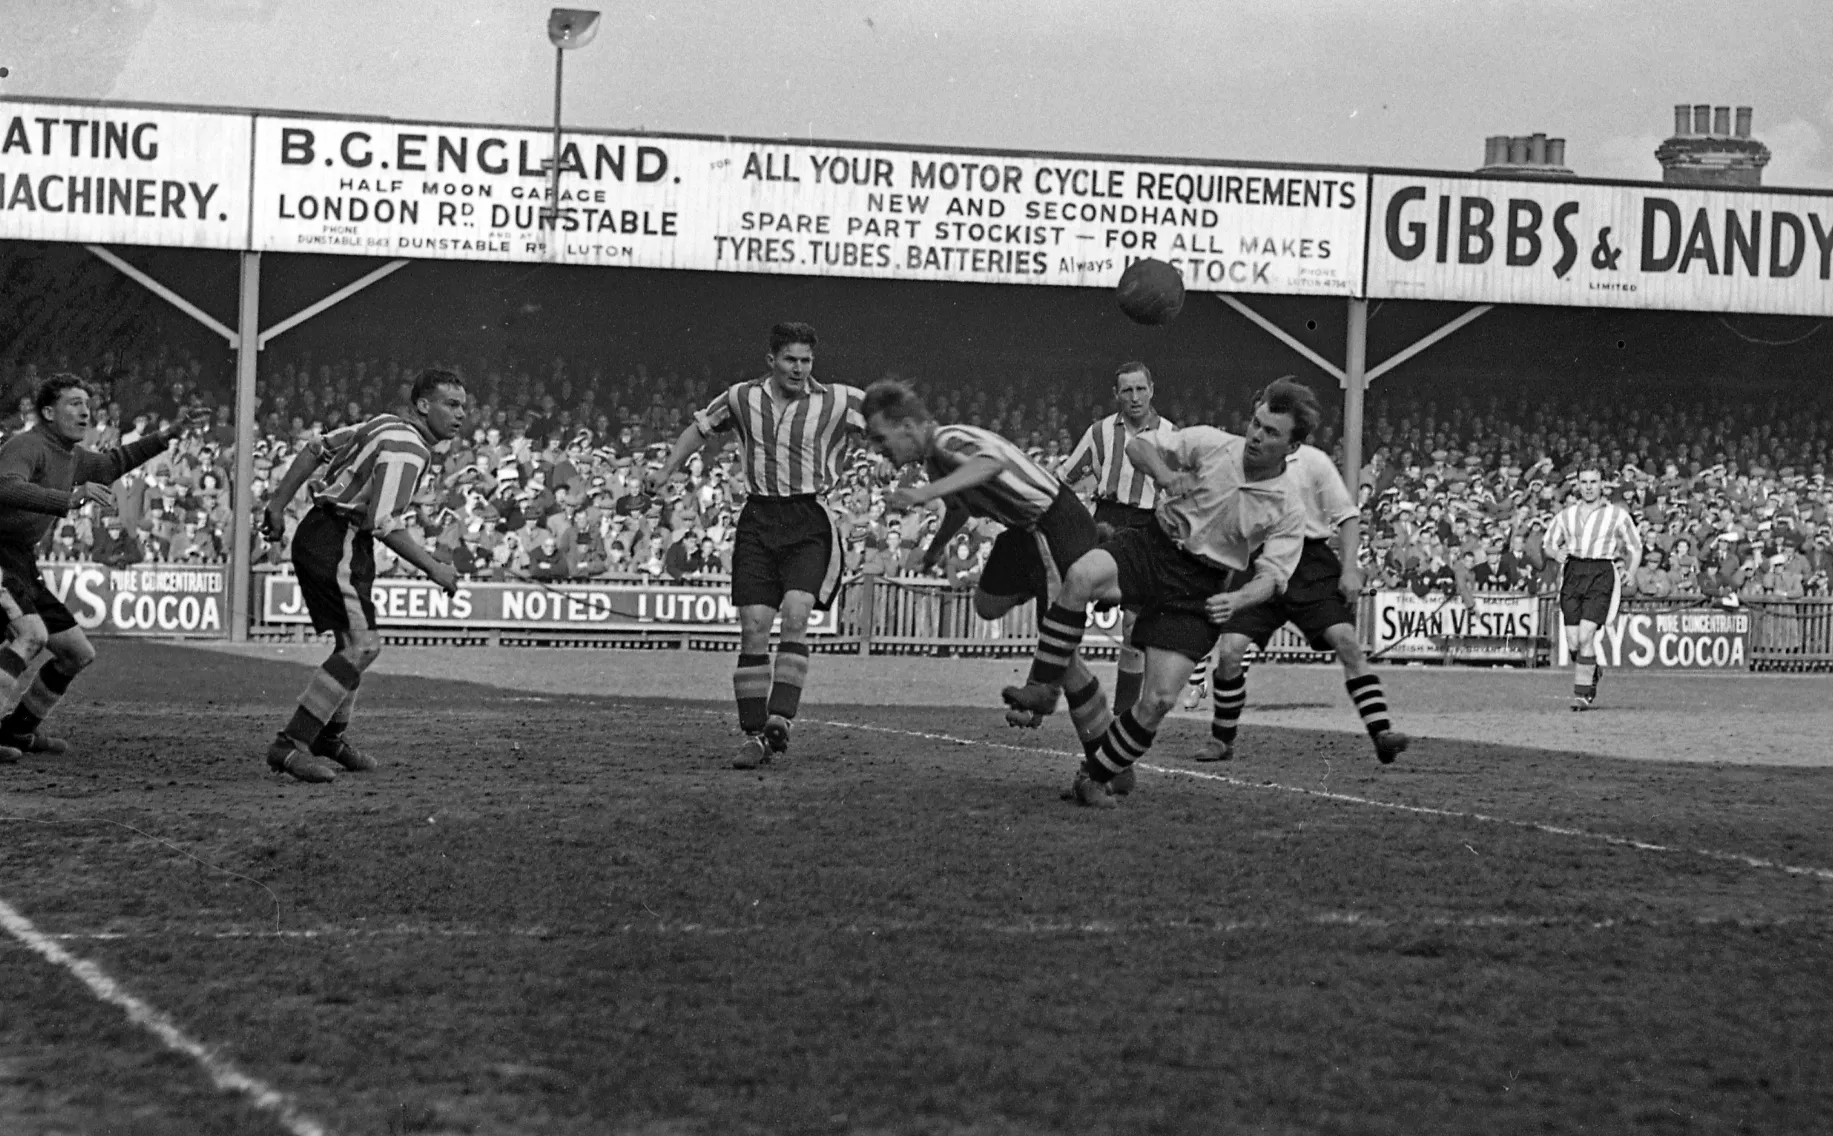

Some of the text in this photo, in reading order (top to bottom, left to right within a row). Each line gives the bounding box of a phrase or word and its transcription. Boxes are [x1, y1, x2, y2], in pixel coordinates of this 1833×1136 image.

[2, 116, 159, 161] ATTING
[0, 172, 228, 222] ACHINERY.
[340, 177, 606, 203] HALF MOON GARAGE
[743, 152, 1356, 210] ALL YOUR MOTOR CYCLE REQUIREMENTS
[279, 193, 419, 226] LONDON
[491, 204, 678, 237] DUNSTABLE
[868, 193, 1219, 228] NEW AND SECONDHAND
[298, 234, 362, 247] DUNSTABLE
[323, 225, 358, 235] PHONE
[398, 236, 510, 252] DUNSTABLE
[567, 244, 633, 257] LUTON
[741, 212, 830, 235] SPARE
[848, 217, 921, 239] PART
[935, 221, 1065, 246] STOCKIST
[1106, 229, 1157, 250] FOR
[1171, 233, 1223, 255] ALL
[1239, 235, 1331, 259] MAKES
[1384, 186, 1833, 280] GIBBS & DANDY
[1058, 256, 1113, 274] Always
[1589, 282, 1637, 291] LIMITED
[110, 570, 223, 593] PURE CONCENTRATED
[112, 591, 220, 630] COCOA
[371, 587, 473, 619] REENS
[502, 590, 612, 622] NOTED
[638, 593, 737, 624] LUTON
[1381, 606, 1531, 641] SWAN VESTAS
[1656, 614, 1749, 633] PURE CONCENTRATED
[1658, 633, 1744, 667] COCOA
